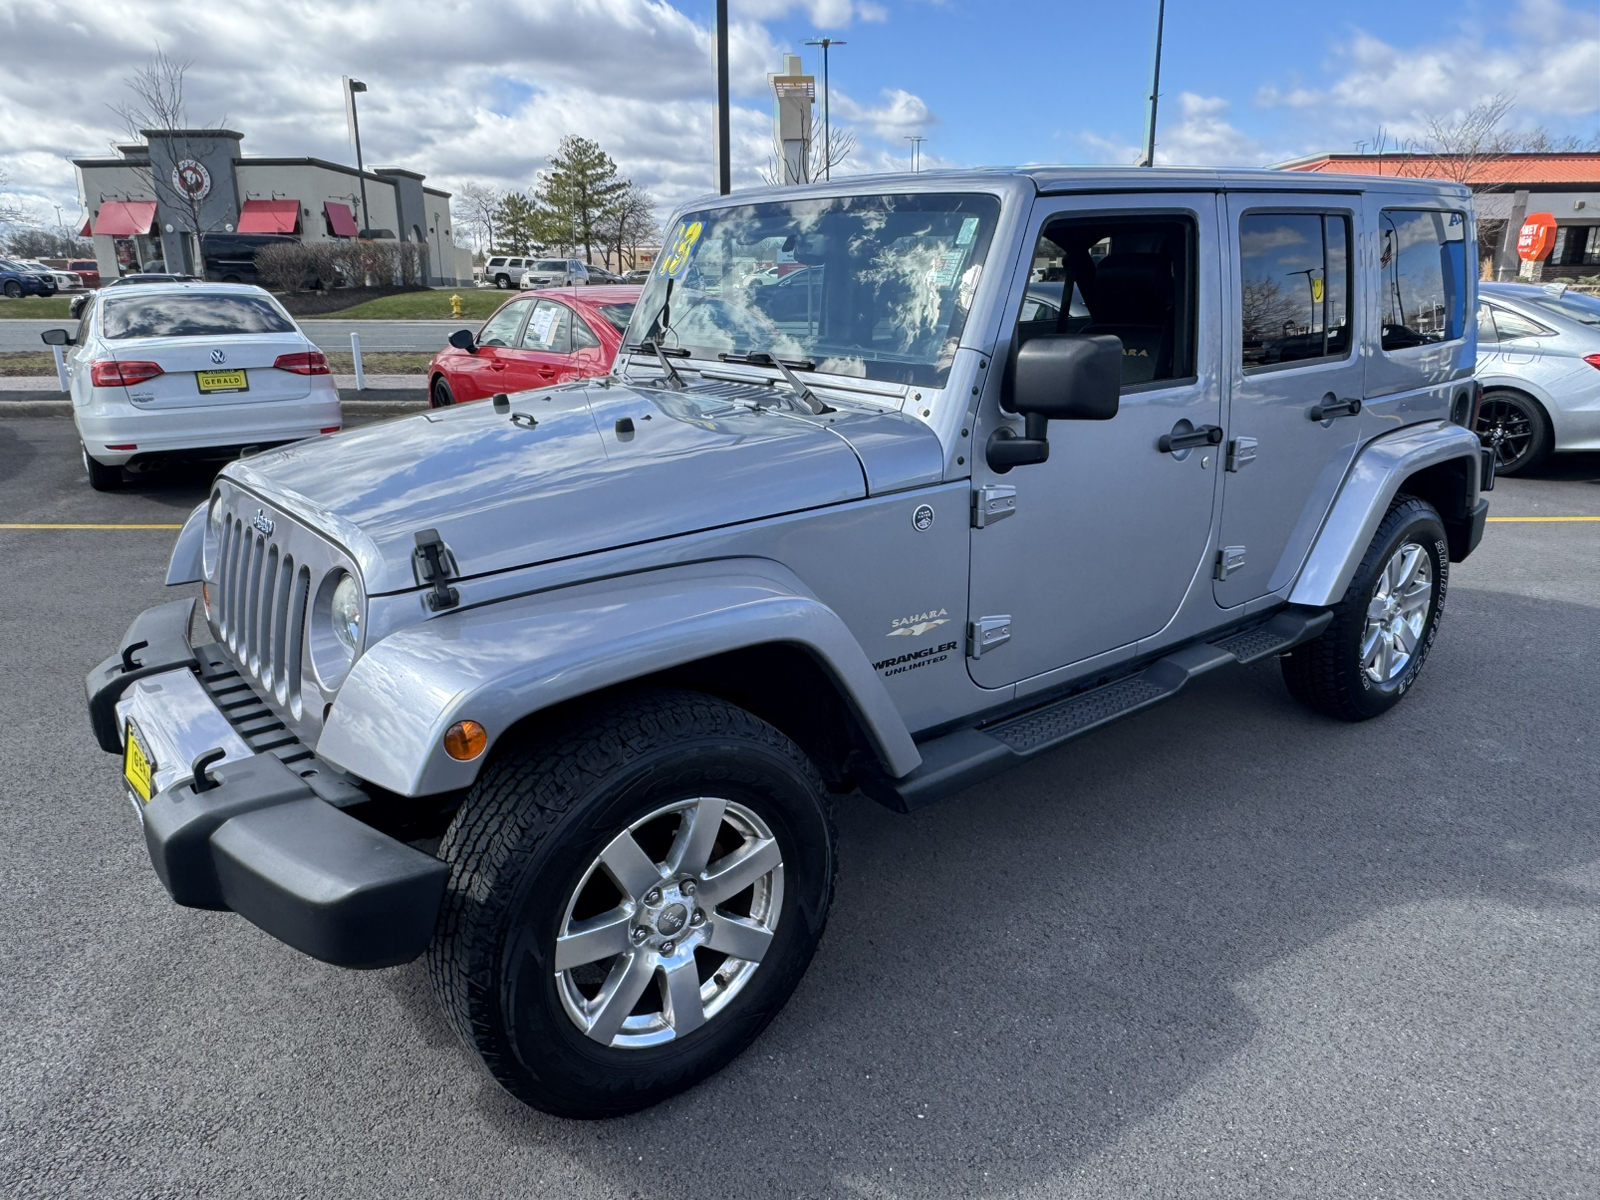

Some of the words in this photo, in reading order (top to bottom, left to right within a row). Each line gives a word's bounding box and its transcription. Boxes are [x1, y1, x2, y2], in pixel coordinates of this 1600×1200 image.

[204, 377, 241, 386] GERALD
[891, 608, 948, 628] SAHARA
[872, 641, 958, 671] WRANGLER
[884, 655, 948, 677] UNLIMITED
[663, 912, 682, 928] Jeep
